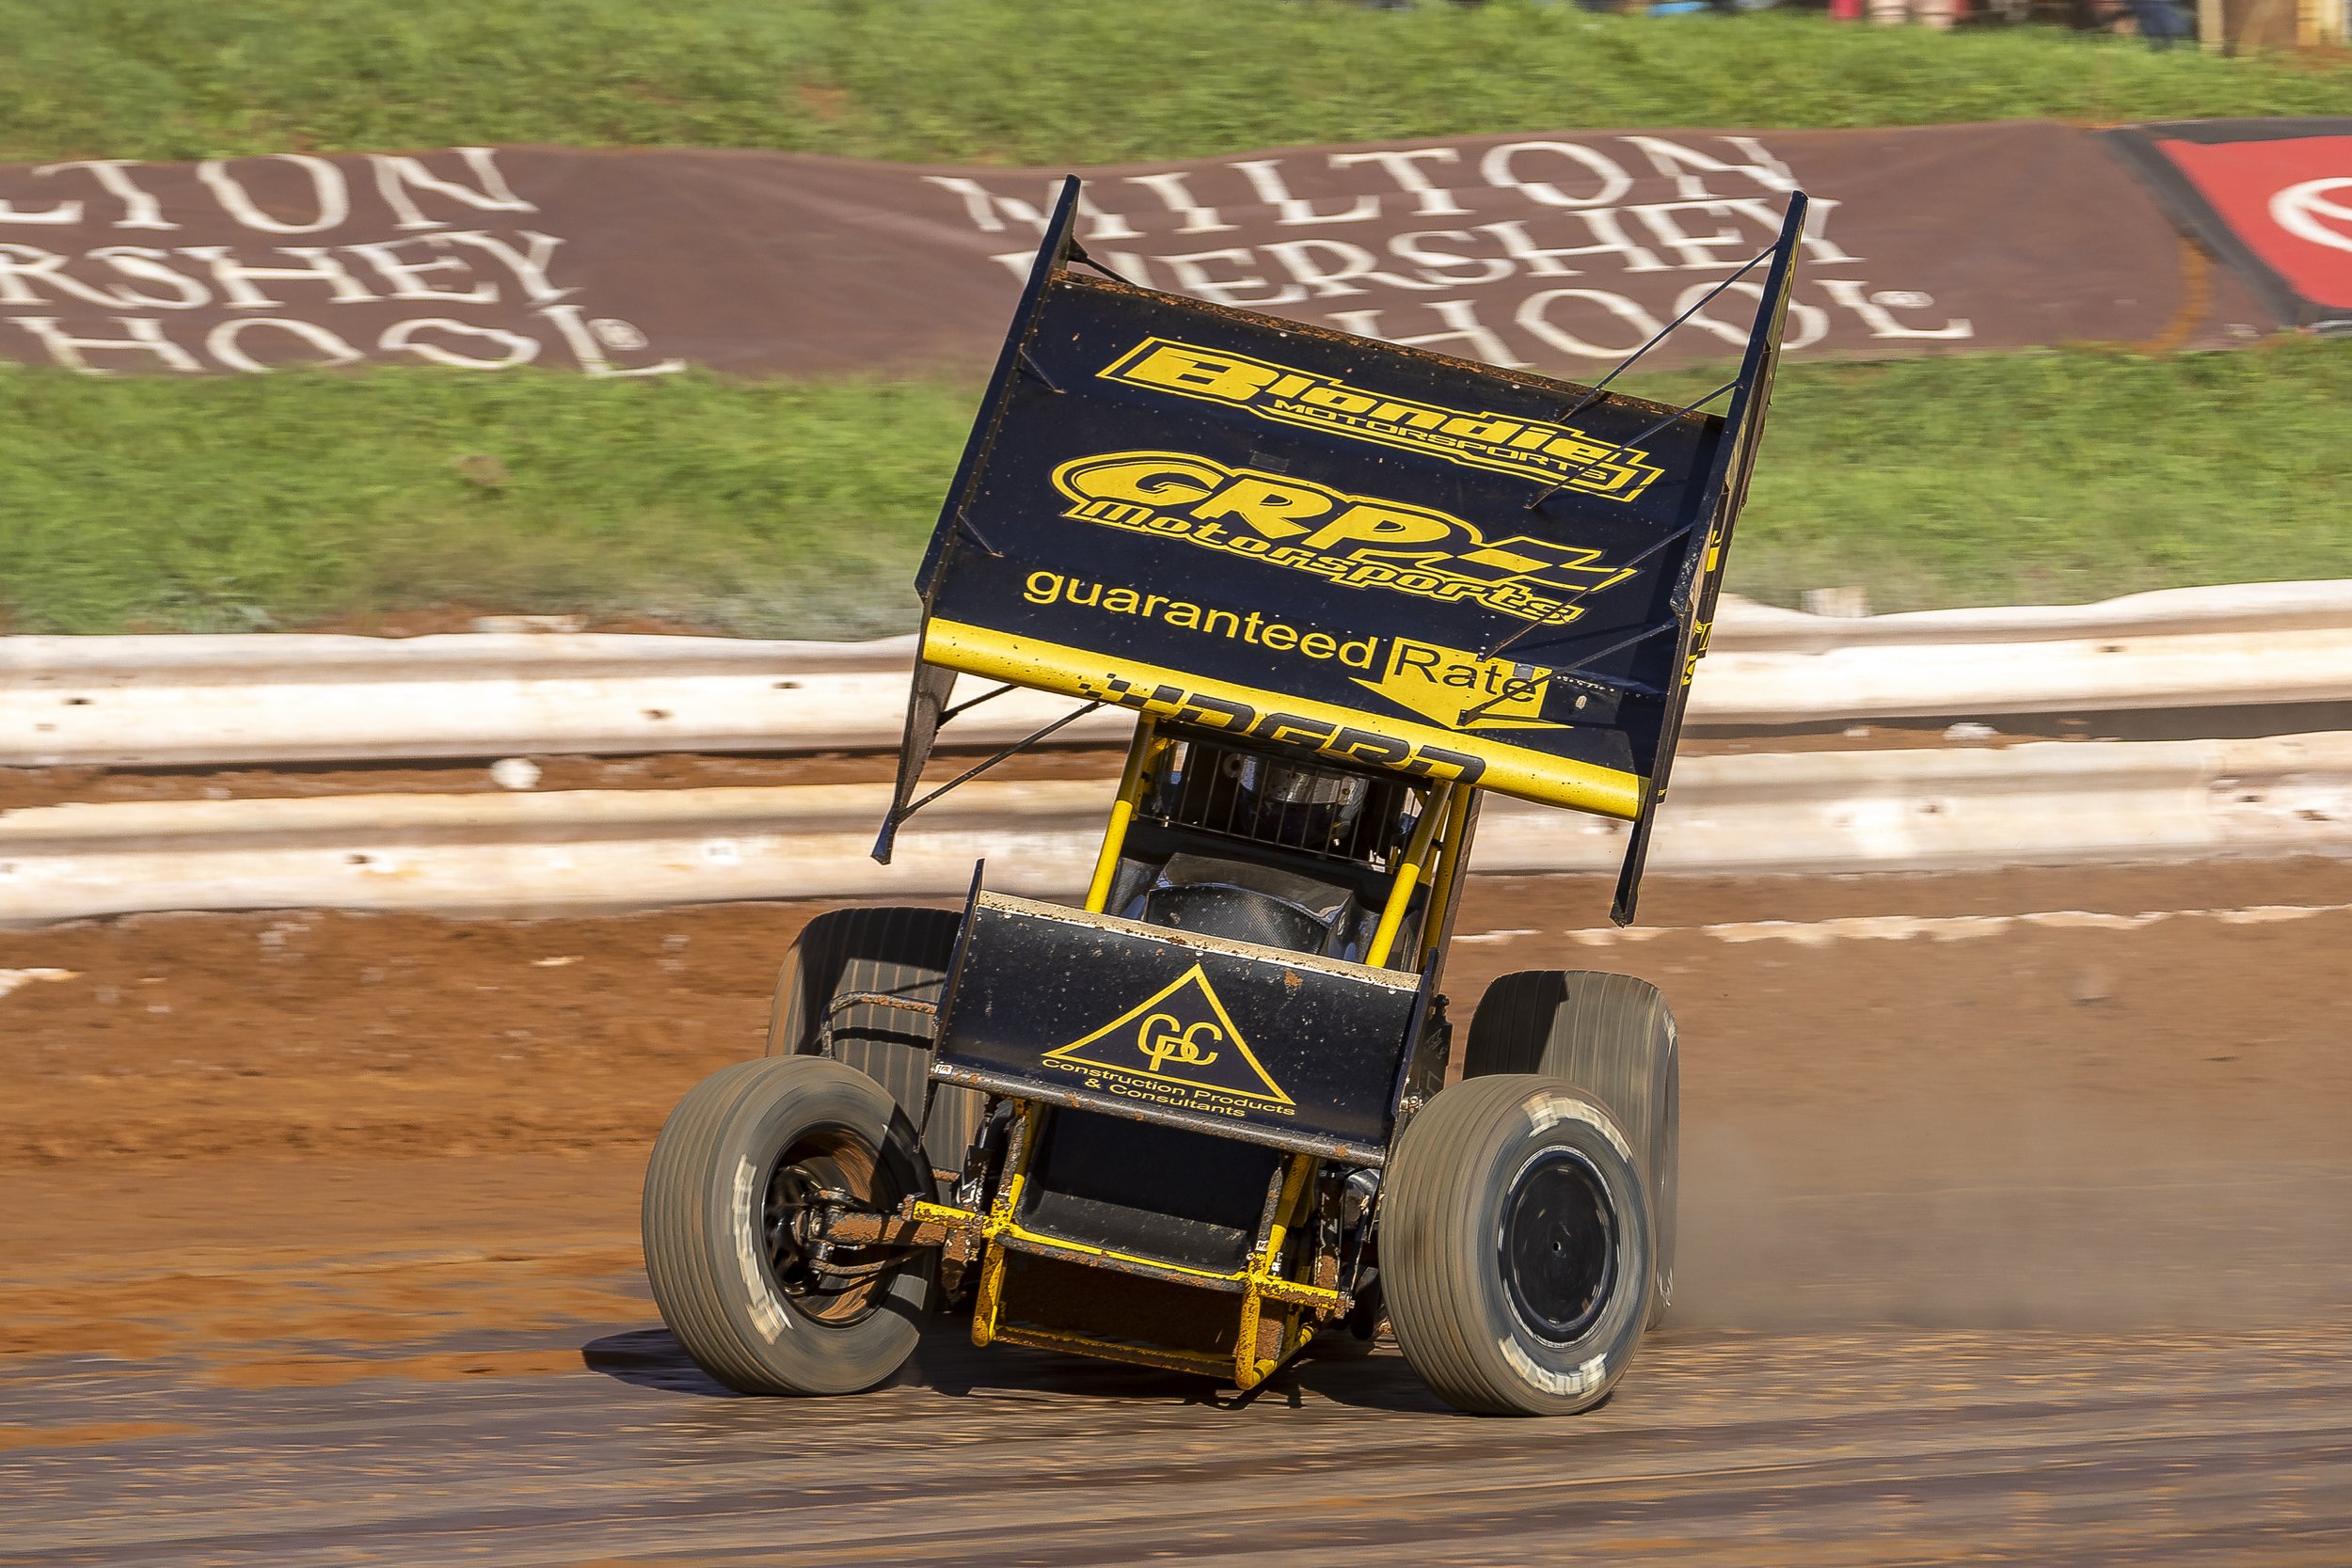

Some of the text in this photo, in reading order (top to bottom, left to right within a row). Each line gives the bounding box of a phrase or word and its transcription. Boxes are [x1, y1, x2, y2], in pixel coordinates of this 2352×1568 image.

[919, 136, 1803, 239] MILTON
[1123, 346, 1615, 465] Blondie
[1274, 400, 1608, 481] MOTORSPORTS
[1071, 461, 1451, 550] GRP
[1024, 571, 1537, 702] guaranteed Rate
[1041, 1059, 1295, 1116] Construction Products
[1085, 1078, 1246, 1117] & Consultants
